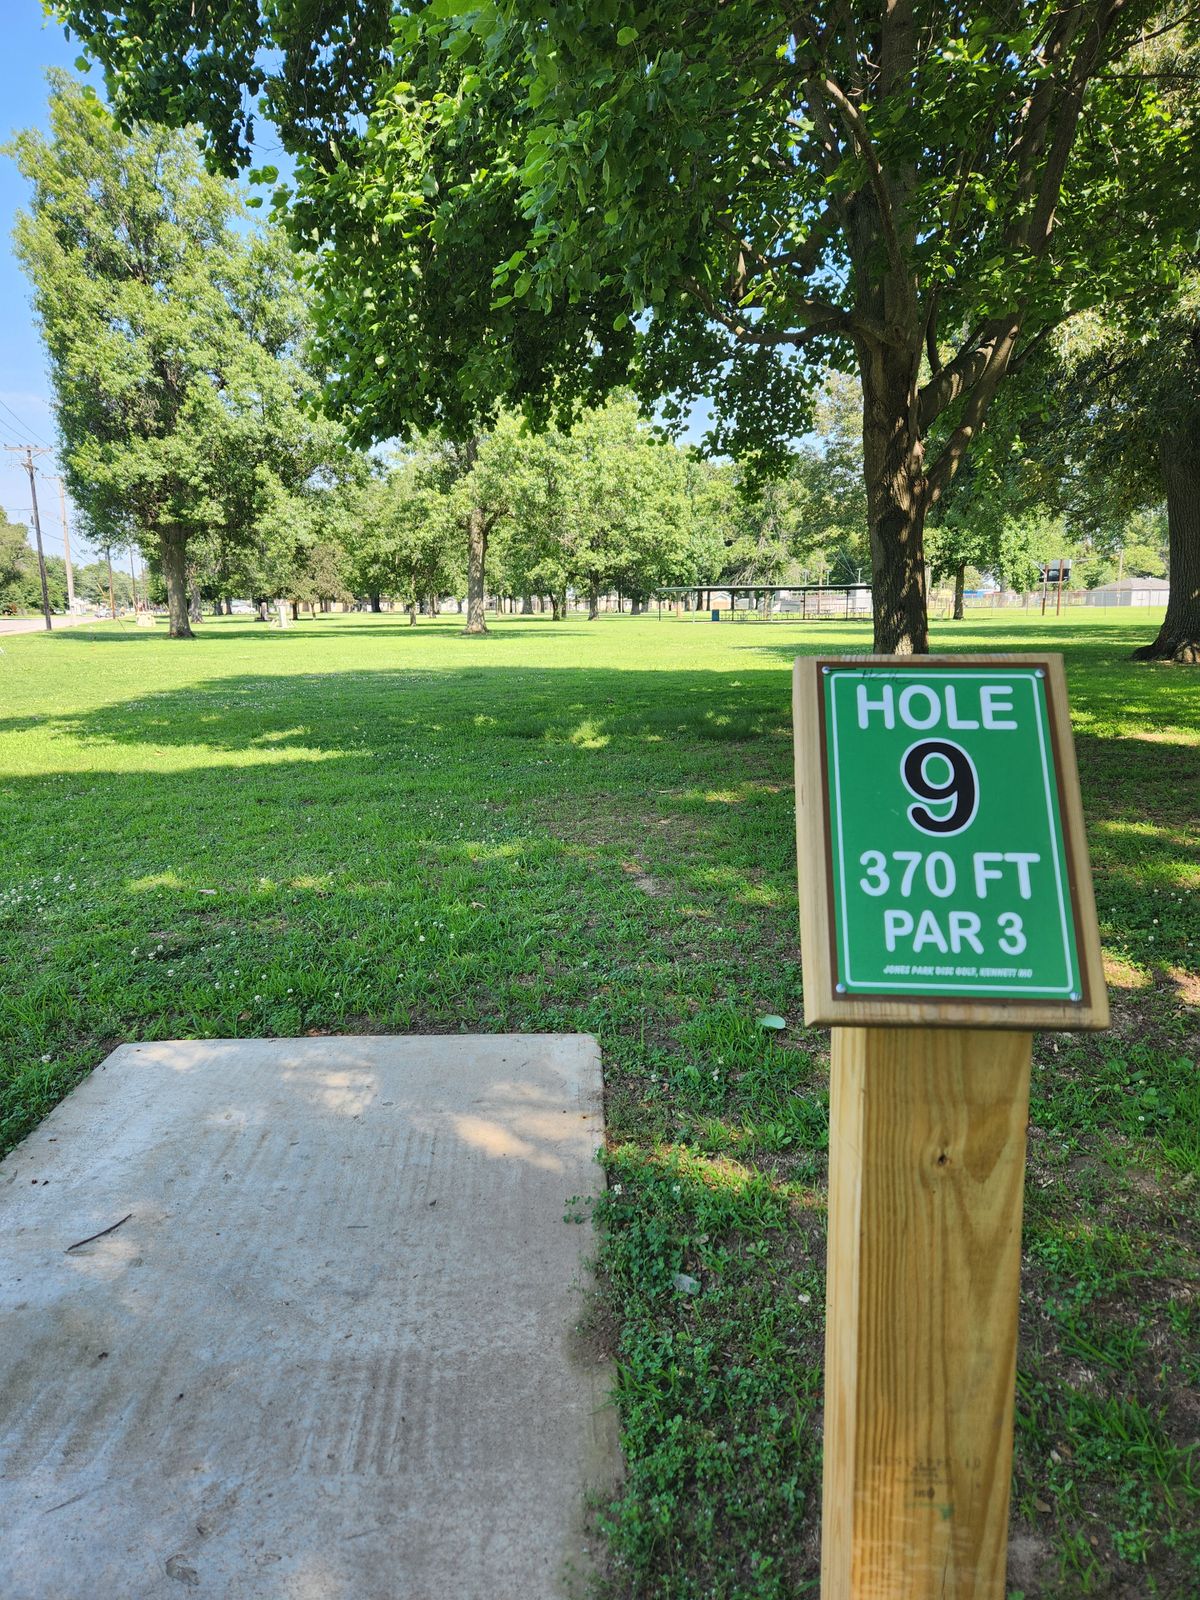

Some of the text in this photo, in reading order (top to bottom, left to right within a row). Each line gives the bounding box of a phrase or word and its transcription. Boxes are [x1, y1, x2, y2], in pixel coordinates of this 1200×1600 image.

[857, 684, 1018, 730] HOLE
[900, 737, 980, 837] 9
[859, 850, 1041, 900] 370 FT
[884, 909, 1028, 956] PAR 3
[883, 965, 910, 975] JONES
[911, 966, 934, 976] PARK
[935, 966, 955, 976] DISC
[1017, 969, 1033, 978] MO
